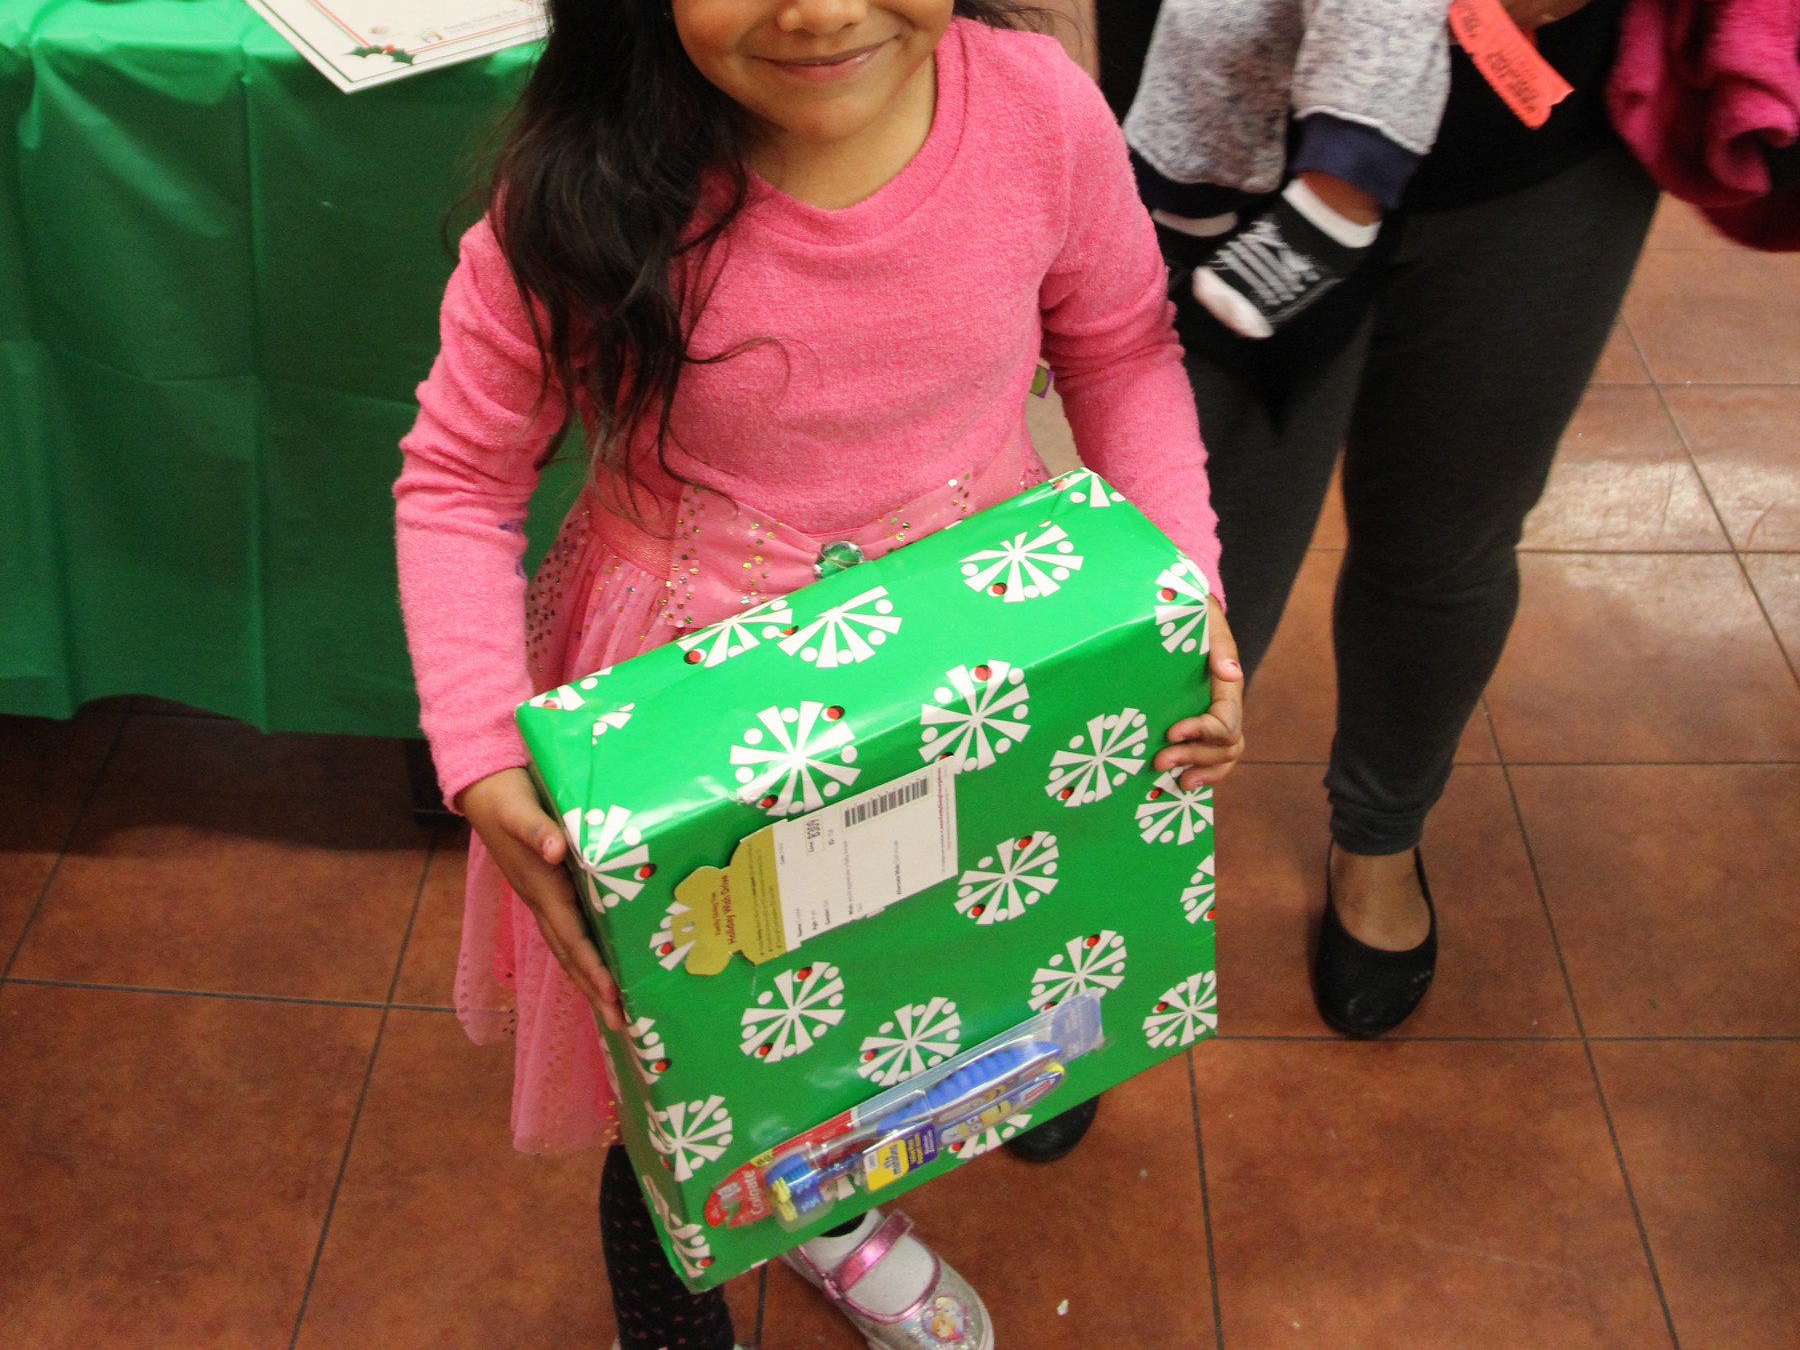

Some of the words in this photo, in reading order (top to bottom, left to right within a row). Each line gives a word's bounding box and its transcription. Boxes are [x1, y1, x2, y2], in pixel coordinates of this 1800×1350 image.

[720, 874, 729, 895] Drive
[722, 896, 732, 914] Wish
[726, 914, 737, 945] Holiday
[742, 1170, 764, 1215] Colgate
